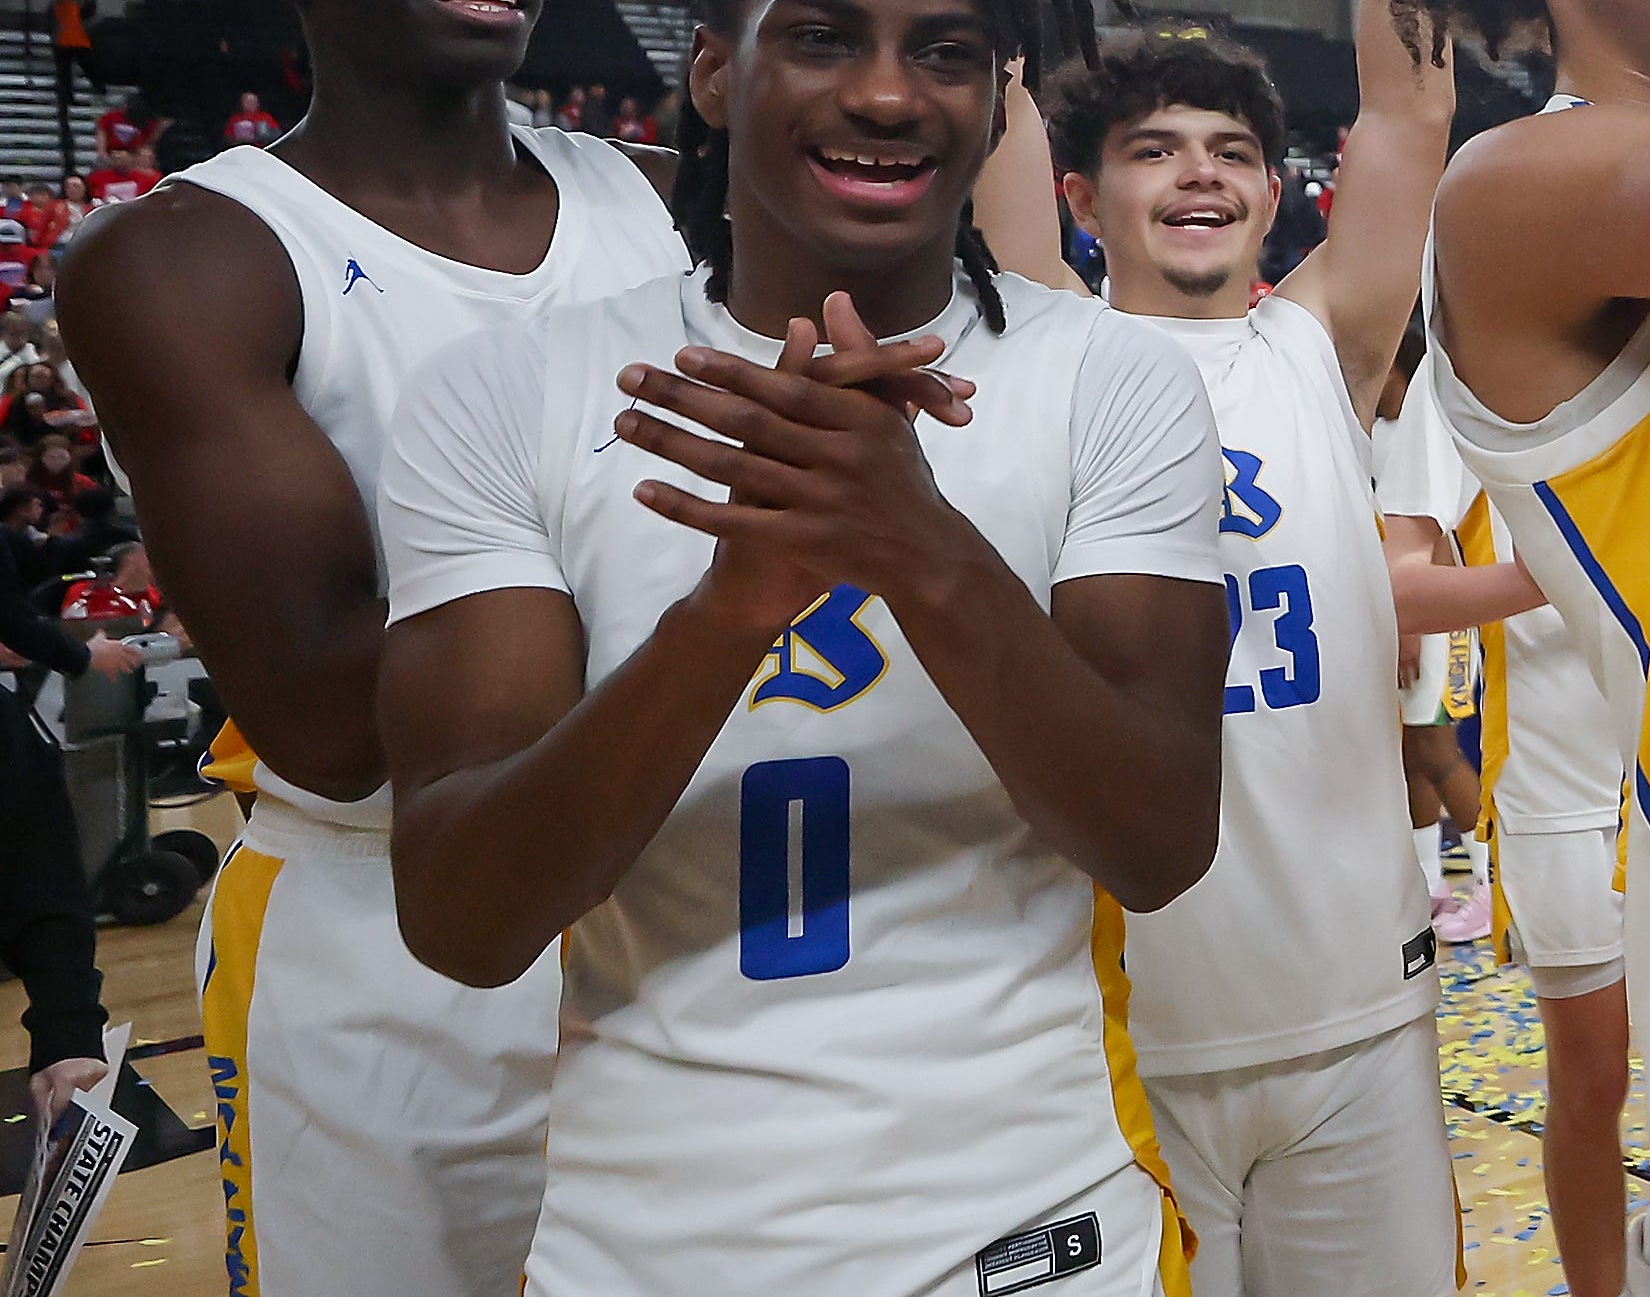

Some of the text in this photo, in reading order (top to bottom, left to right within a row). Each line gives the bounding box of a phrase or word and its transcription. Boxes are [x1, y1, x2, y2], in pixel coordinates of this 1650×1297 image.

[739, 755, 852, 982] 0
[64, 1119, 113, 1202] STATE
[1067, 1234, 1082, 1256] S
